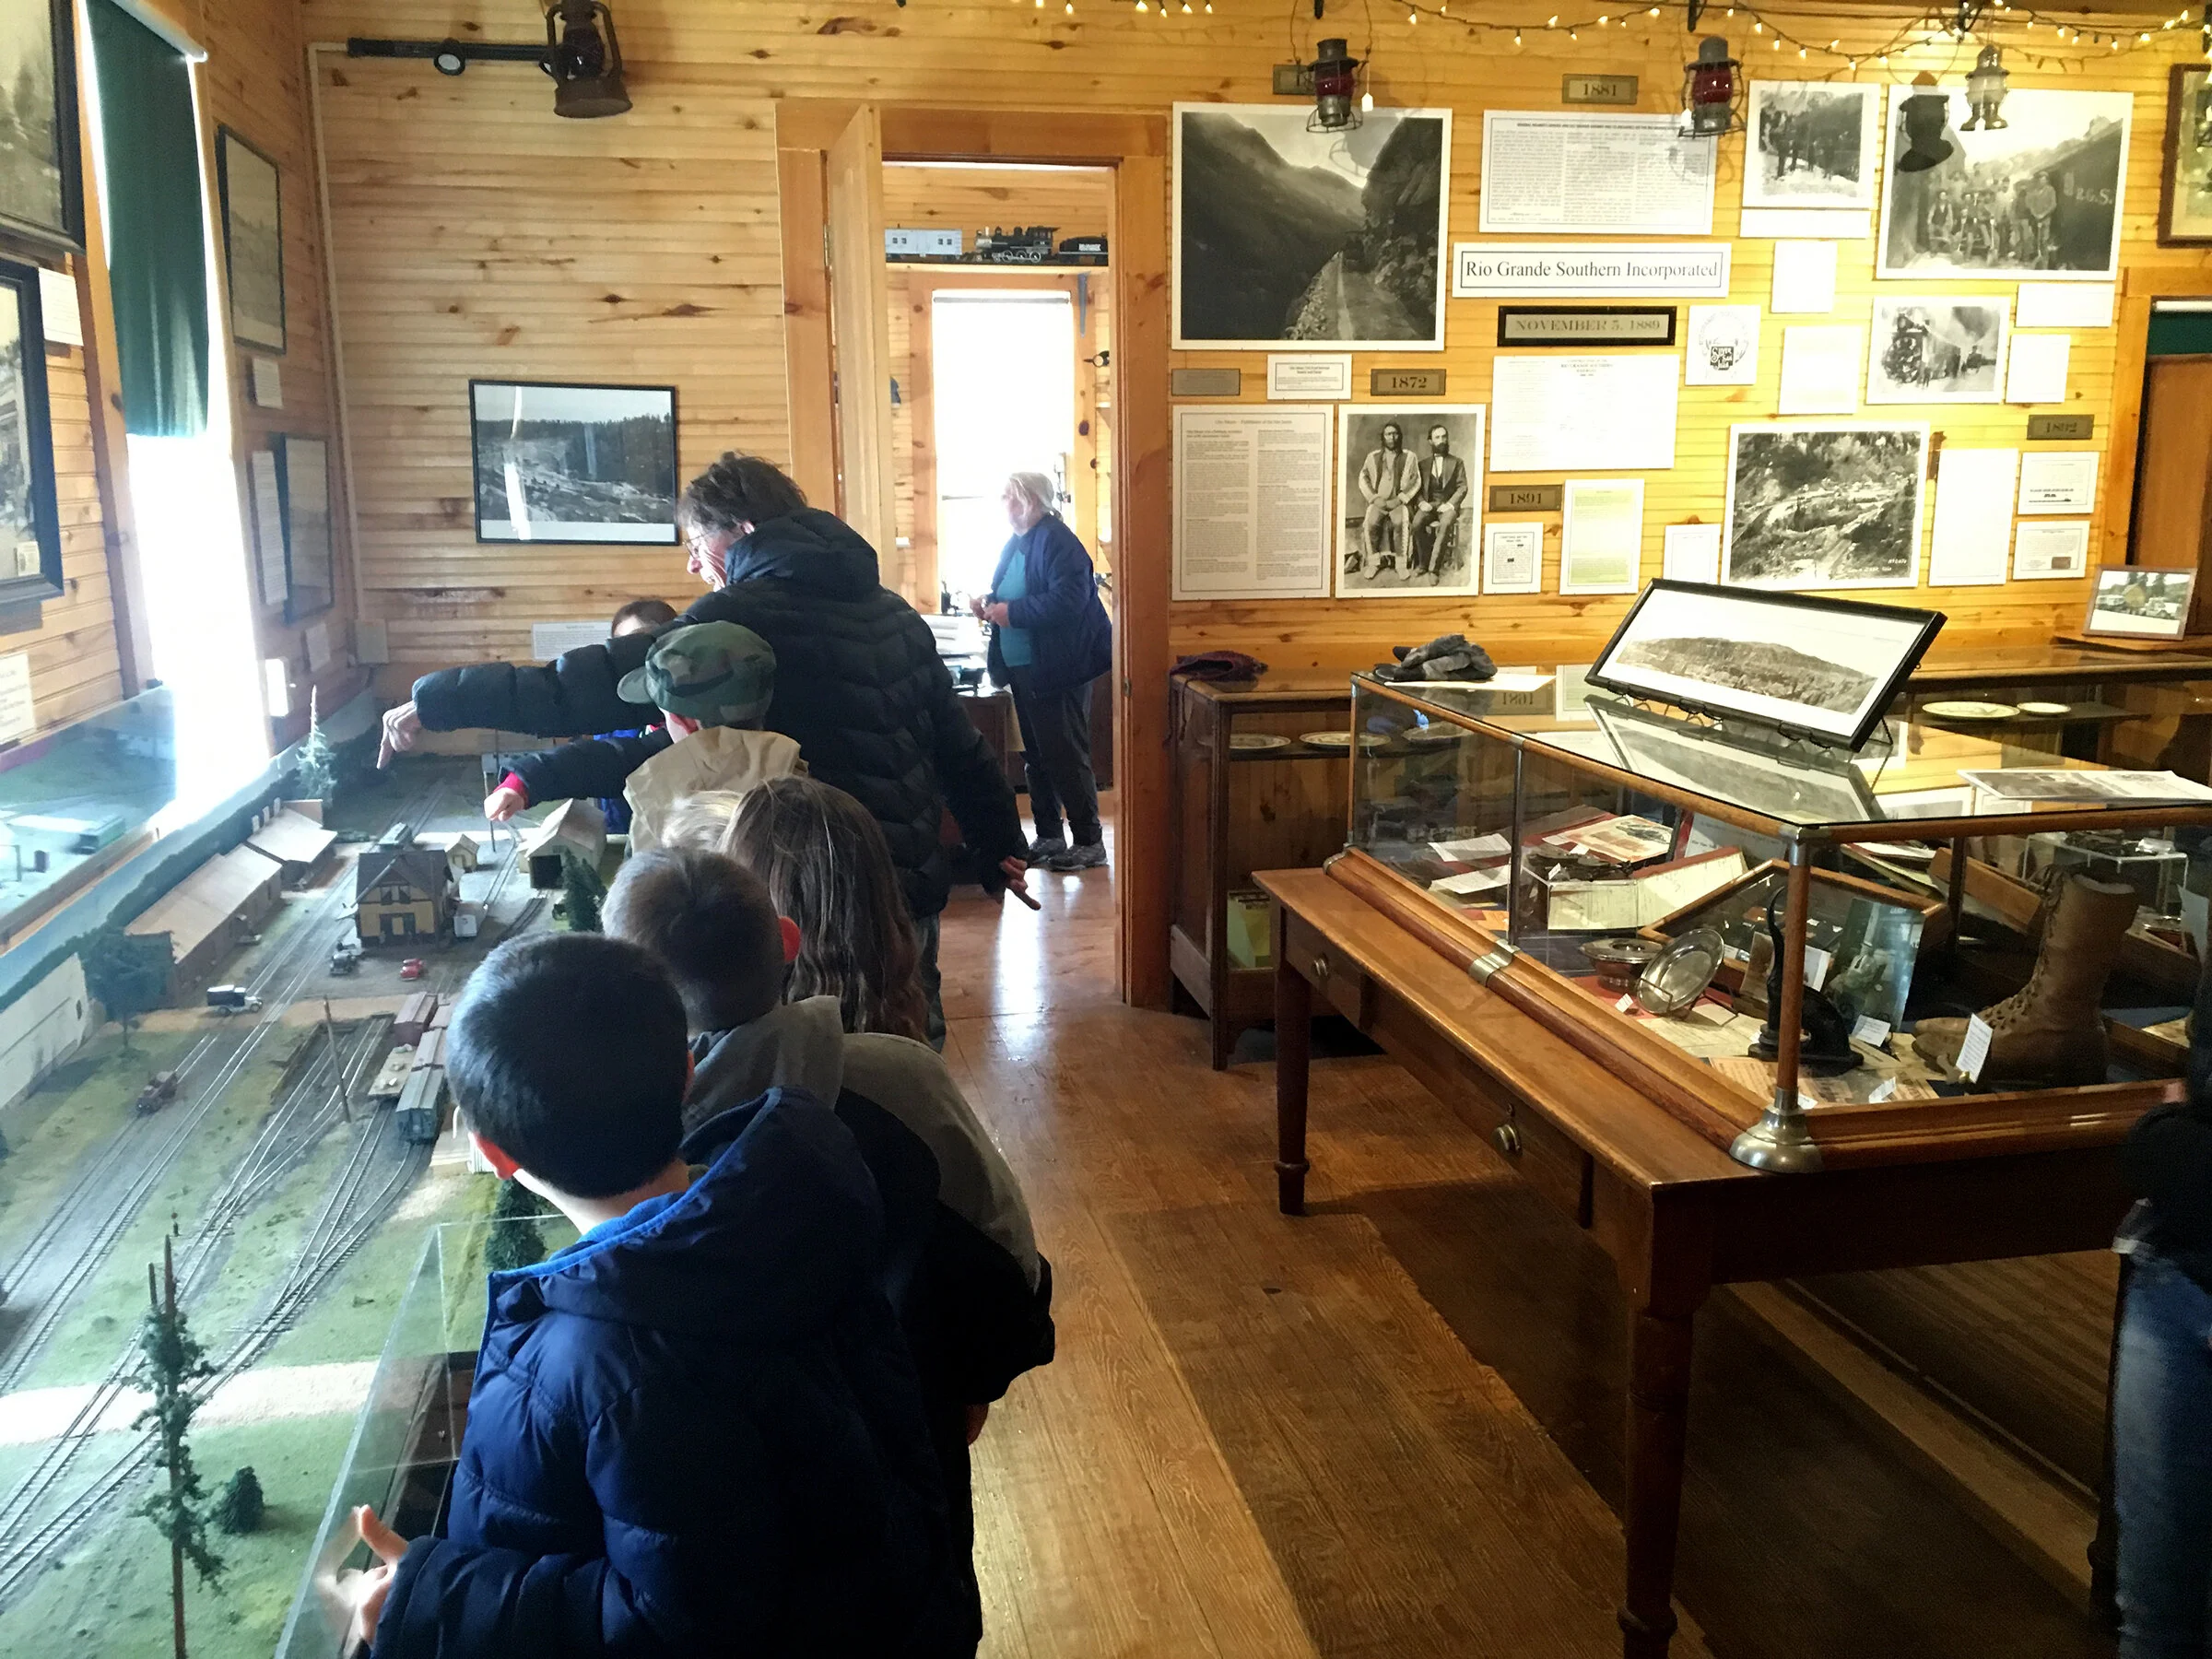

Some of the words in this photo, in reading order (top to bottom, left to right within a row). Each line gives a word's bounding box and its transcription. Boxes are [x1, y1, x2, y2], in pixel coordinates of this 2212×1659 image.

[1583, 83, 1617, 97] 1881
[1465, 261, 1492, 276] Rio
[1497, 261, 1551, 276] Grande
[1556, 261, 1621, 276] Southern
[1627, 261, 1717, 279] Incorporated
[1515, 320, 1607, 331] NOVEMBER
[1630, 320, 1661, 331] 1889
[1392, 376, 1427, 388] 1872
